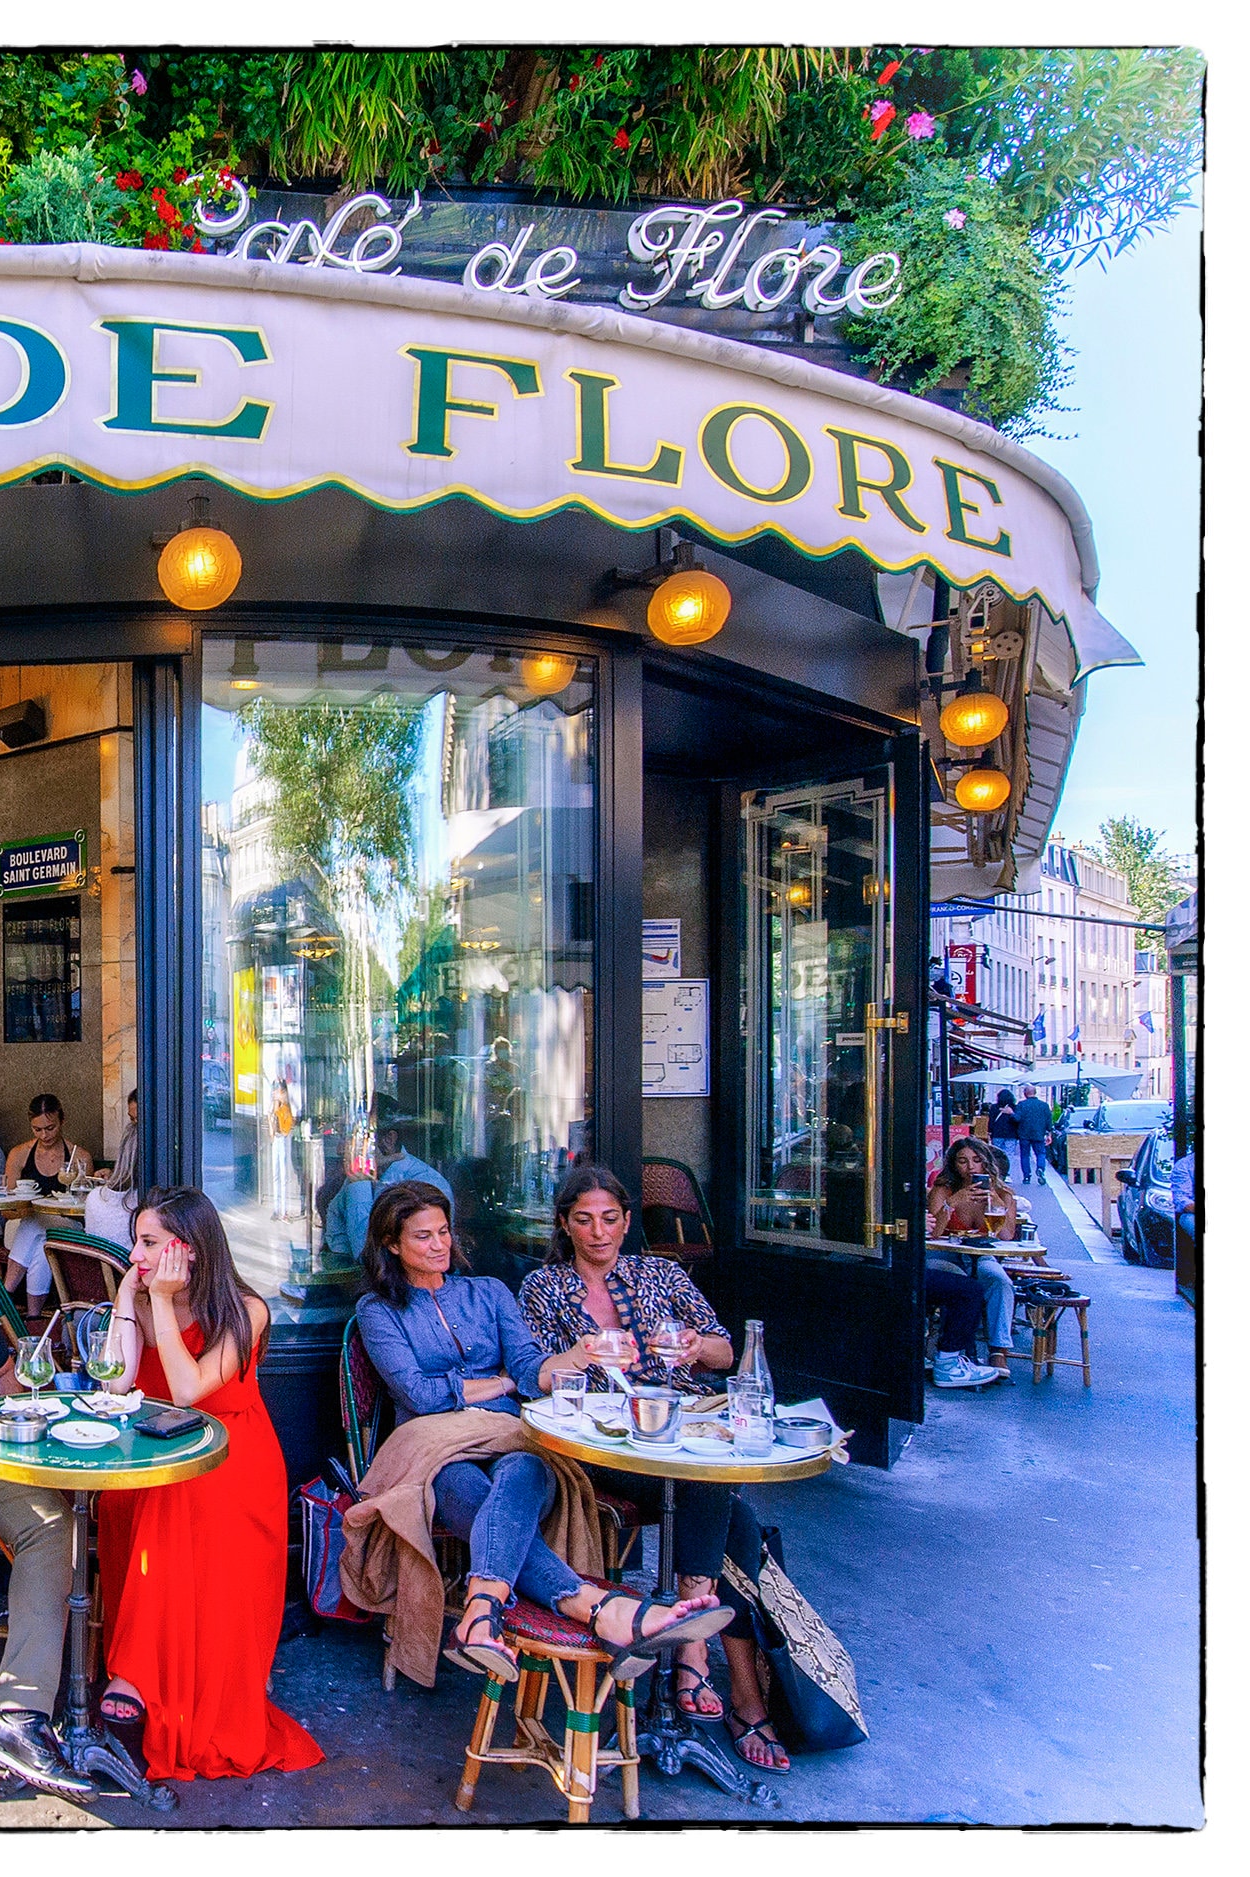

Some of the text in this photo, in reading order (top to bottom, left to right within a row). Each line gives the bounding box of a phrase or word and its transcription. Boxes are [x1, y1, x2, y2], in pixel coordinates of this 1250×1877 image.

[463, 223, 582, 300] de
[620, 199, 903, 316] Flore
[397, 343, 1013, 559] FLORE
[2, 860, 77, 885] SAINT GERMAIN
[9, 845, 68, 868] BOULEVARD
